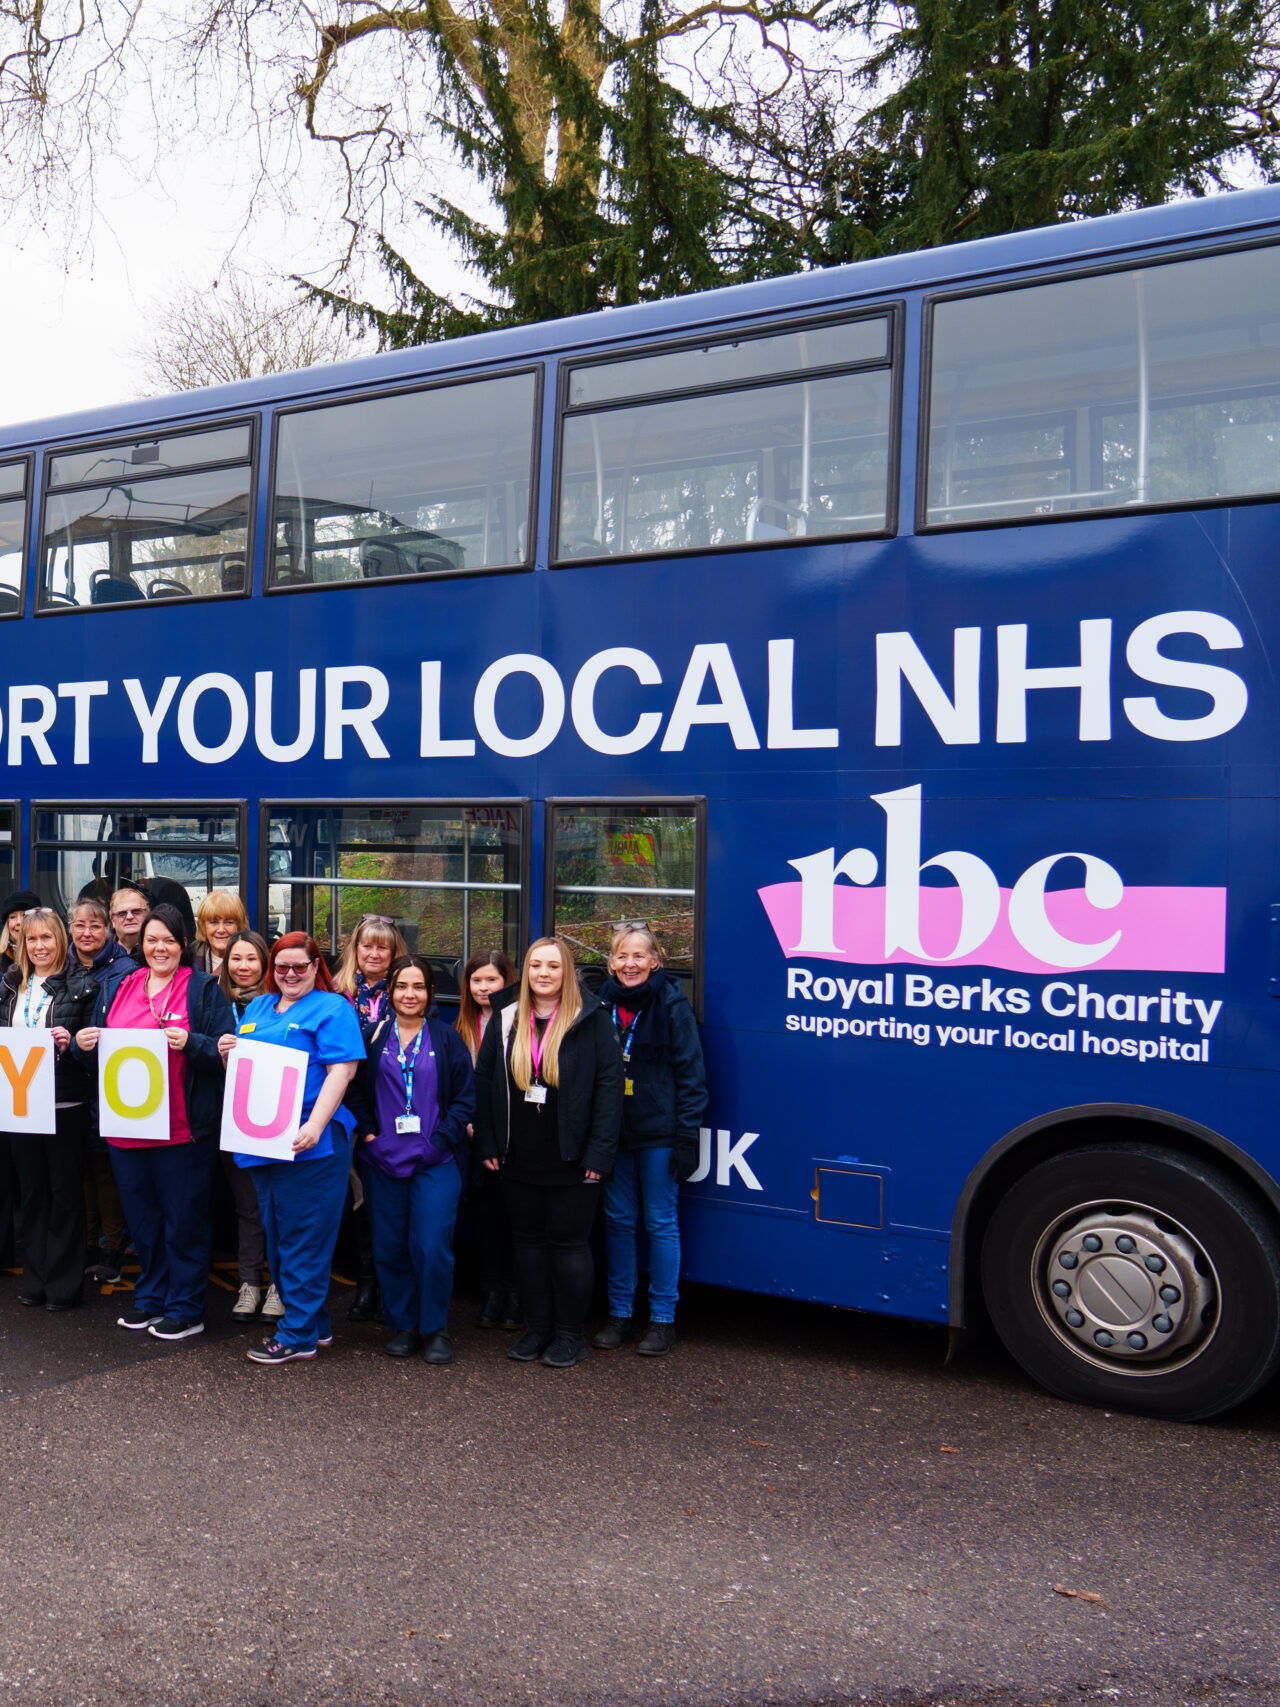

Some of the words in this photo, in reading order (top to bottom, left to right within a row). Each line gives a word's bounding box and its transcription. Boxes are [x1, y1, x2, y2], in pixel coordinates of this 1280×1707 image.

[123, 665, 390, 763] YOUR
[420, 638, 838, 757] LOCAL
[875, 610, 1248, 747] NHS
[787, 783, 1123, 967] rbc
[786, 1013, 930, 1046] supporting
[936, 1026, 1000, 1047] your
[1004, 1025, 1075, 1052] local
[1082, 1030, 1210, 1062] hospital
[787, 967, 893, 1009] Royal
[906, 973, 1031, 1013] Berks
[1041, 981, 1223, 1034] Charity
